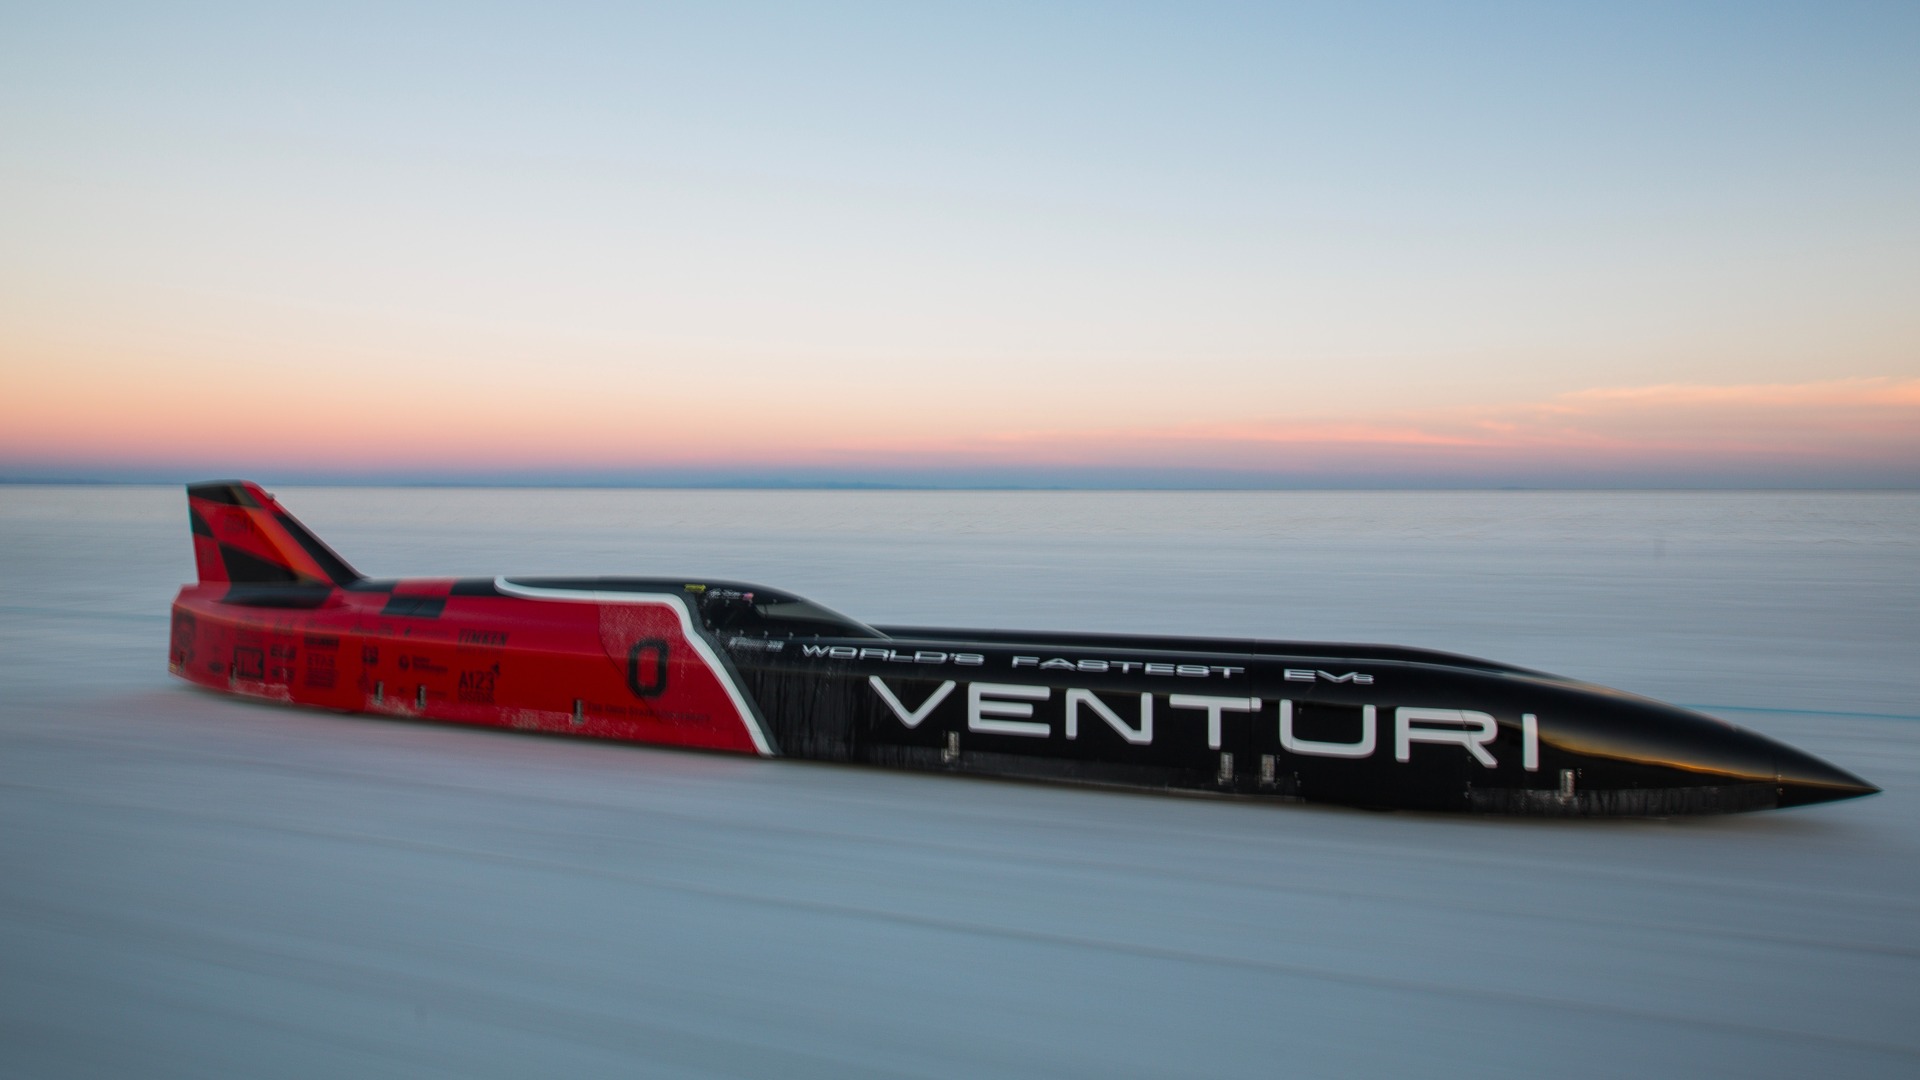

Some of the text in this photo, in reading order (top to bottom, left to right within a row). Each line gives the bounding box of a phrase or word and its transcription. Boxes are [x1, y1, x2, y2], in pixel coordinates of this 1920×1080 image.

[802, 644, 985, 666] WORLD'S
[1012, 656, 1245, 678] FASTEST
[458, 670, 496, 690] A123
[868, 676, 1538, 771] VENTURI
